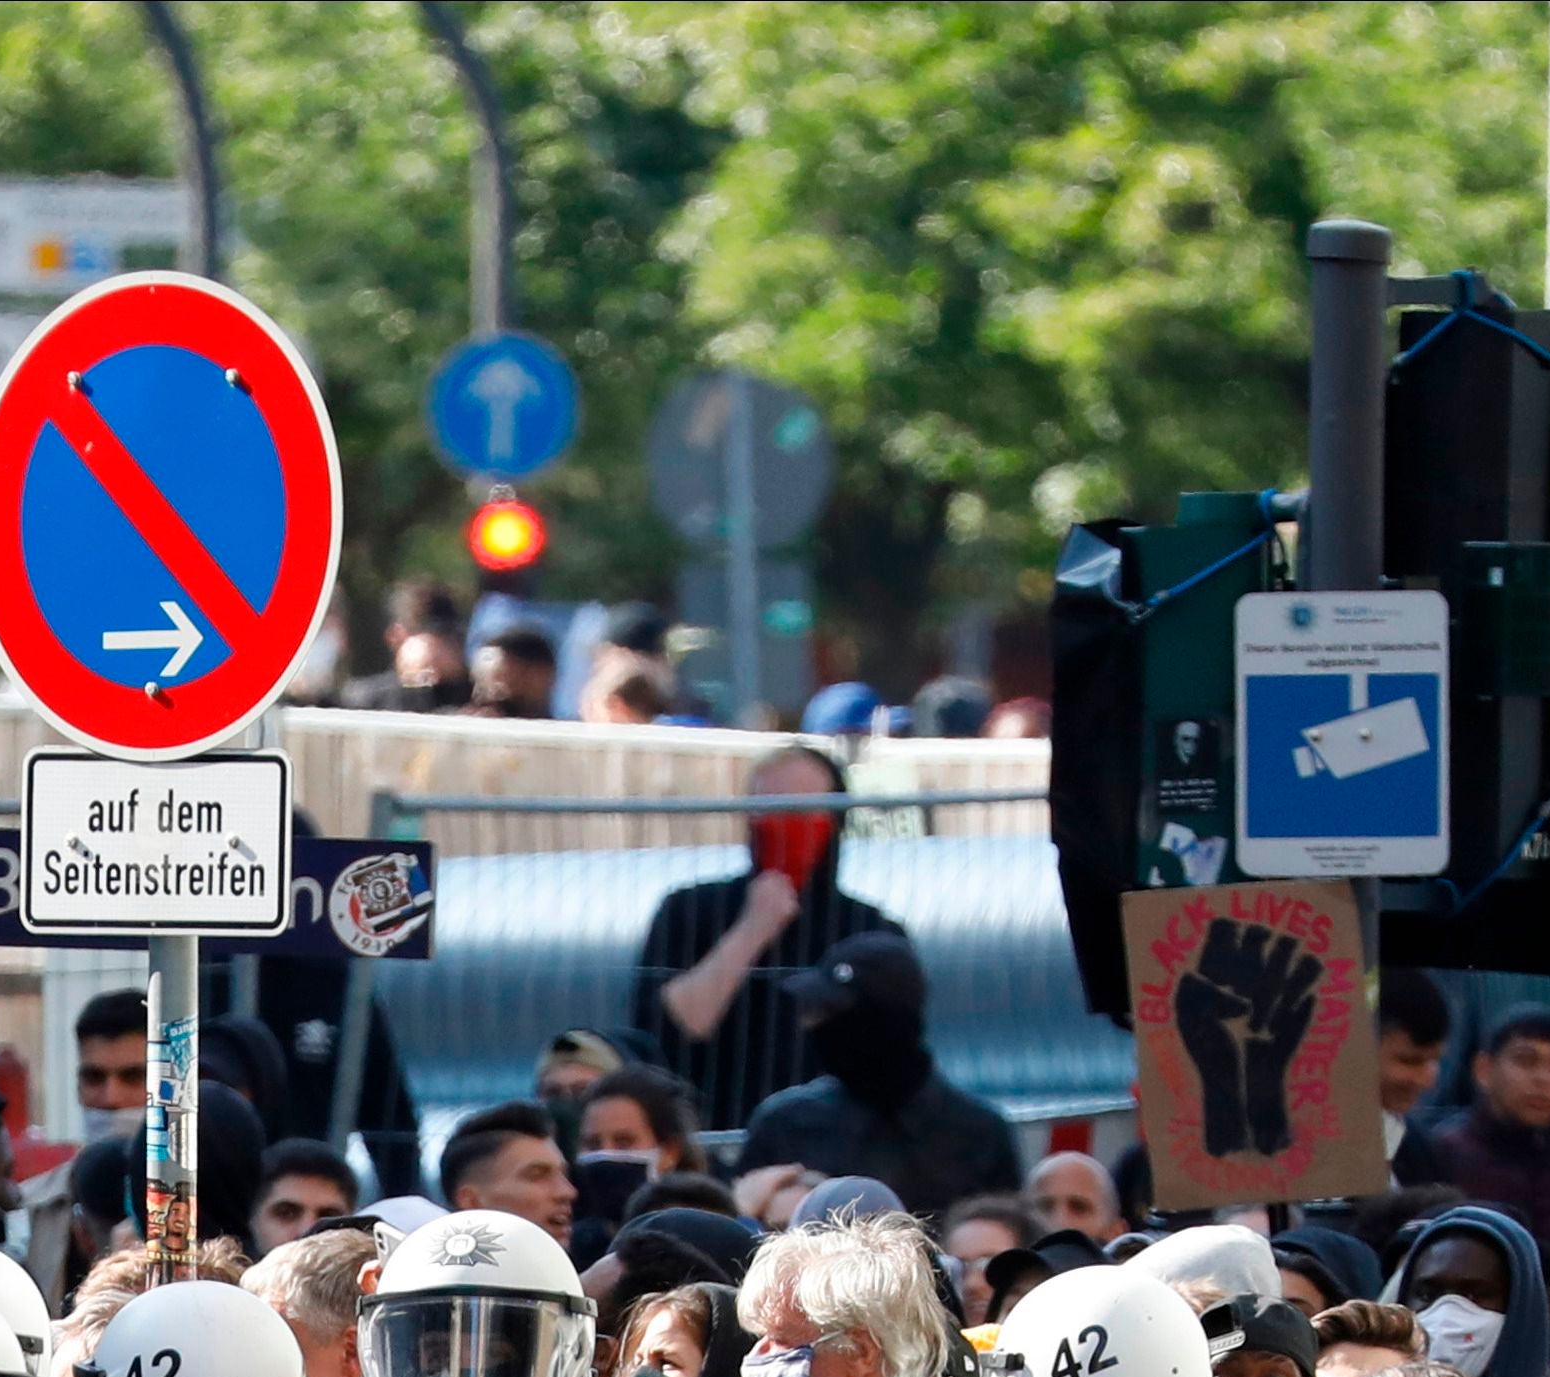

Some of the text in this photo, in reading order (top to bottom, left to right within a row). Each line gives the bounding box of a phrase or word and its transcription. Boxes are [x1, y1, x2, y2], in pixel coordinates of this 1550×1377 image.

[88, 788, 223, 834] auf dem
[43, 849, 266, 898] Seitenstreifen
[1229, 891, 1334, 954] LIVES
[1138, 894, 1216, 1024] BLACK
